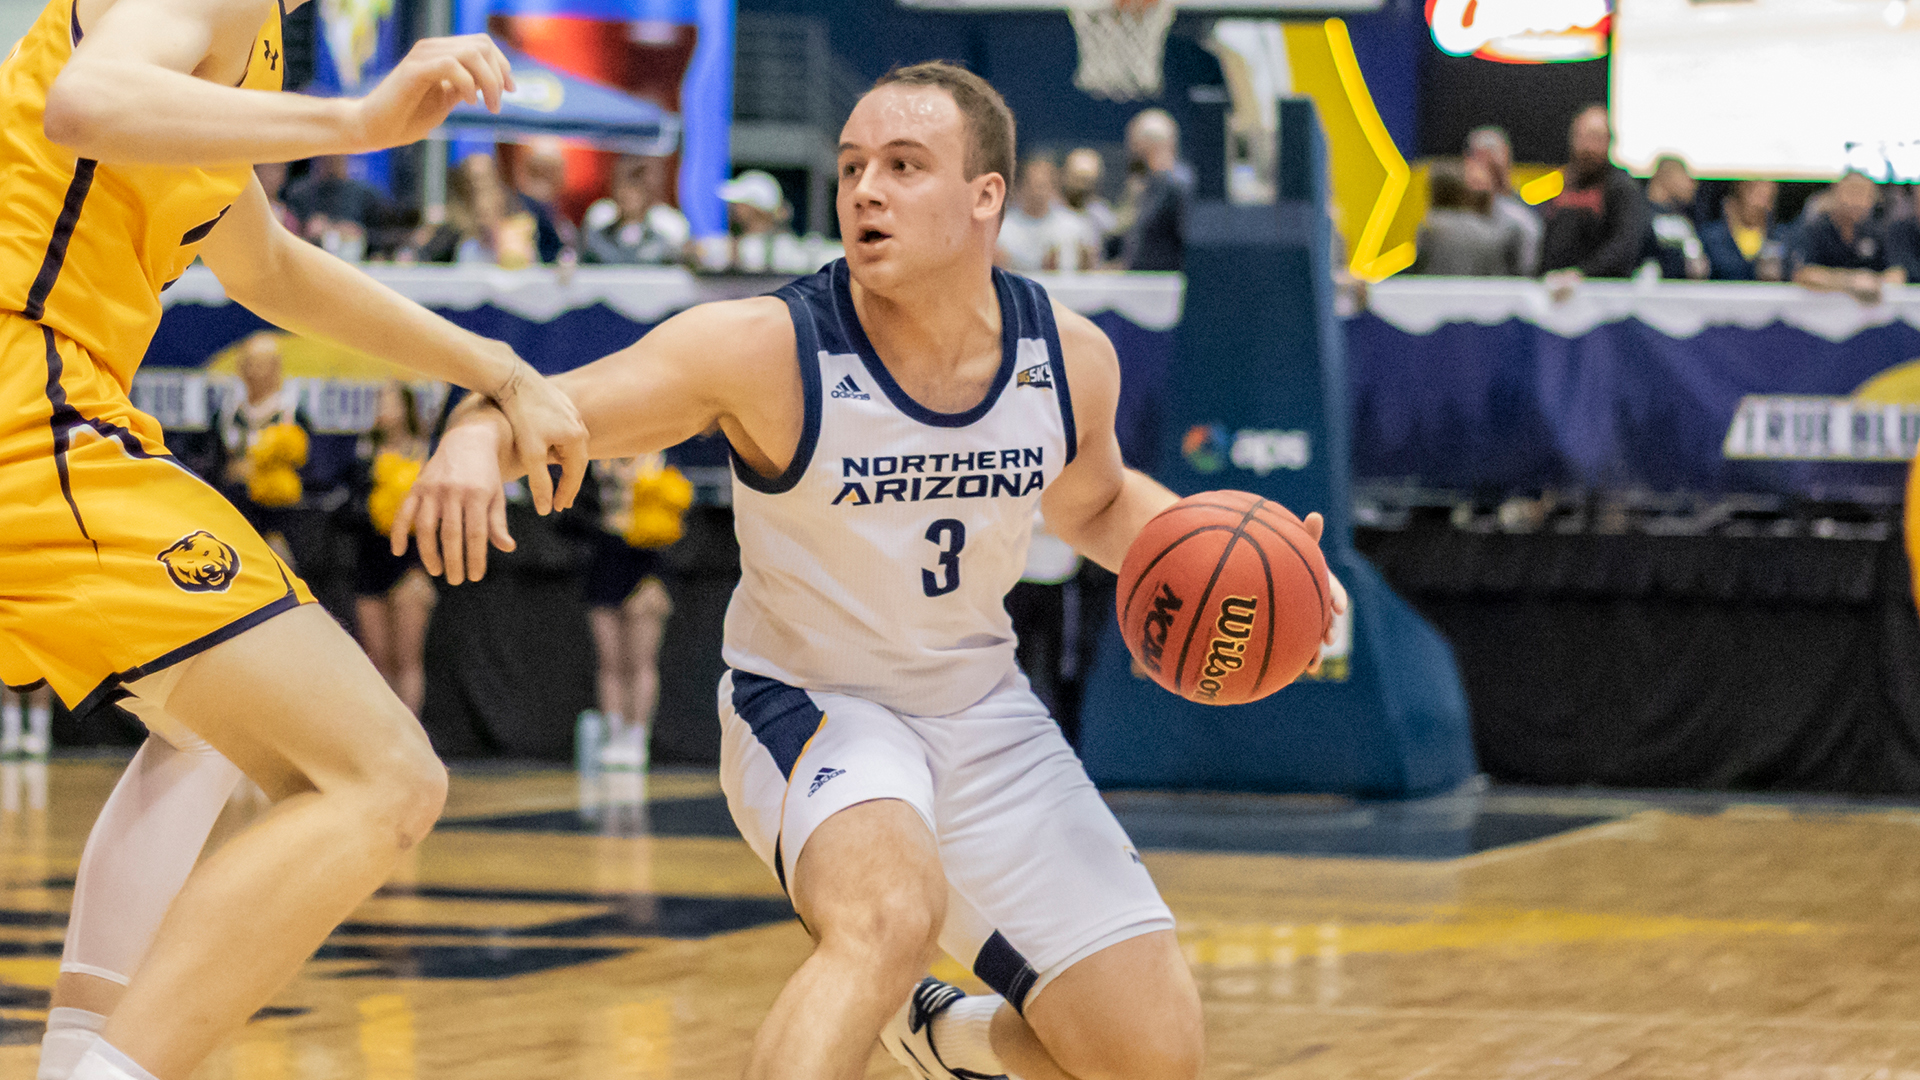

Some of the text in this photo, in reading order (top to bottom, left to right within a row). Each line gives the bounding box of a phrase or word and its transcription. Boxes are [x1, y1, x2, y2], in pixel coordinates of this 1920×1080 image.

[842, 447, 1043, 477] NORTHERN
[830, 470, 1044, 506] ARIZONA
[921, 518, 966, 597] 3
